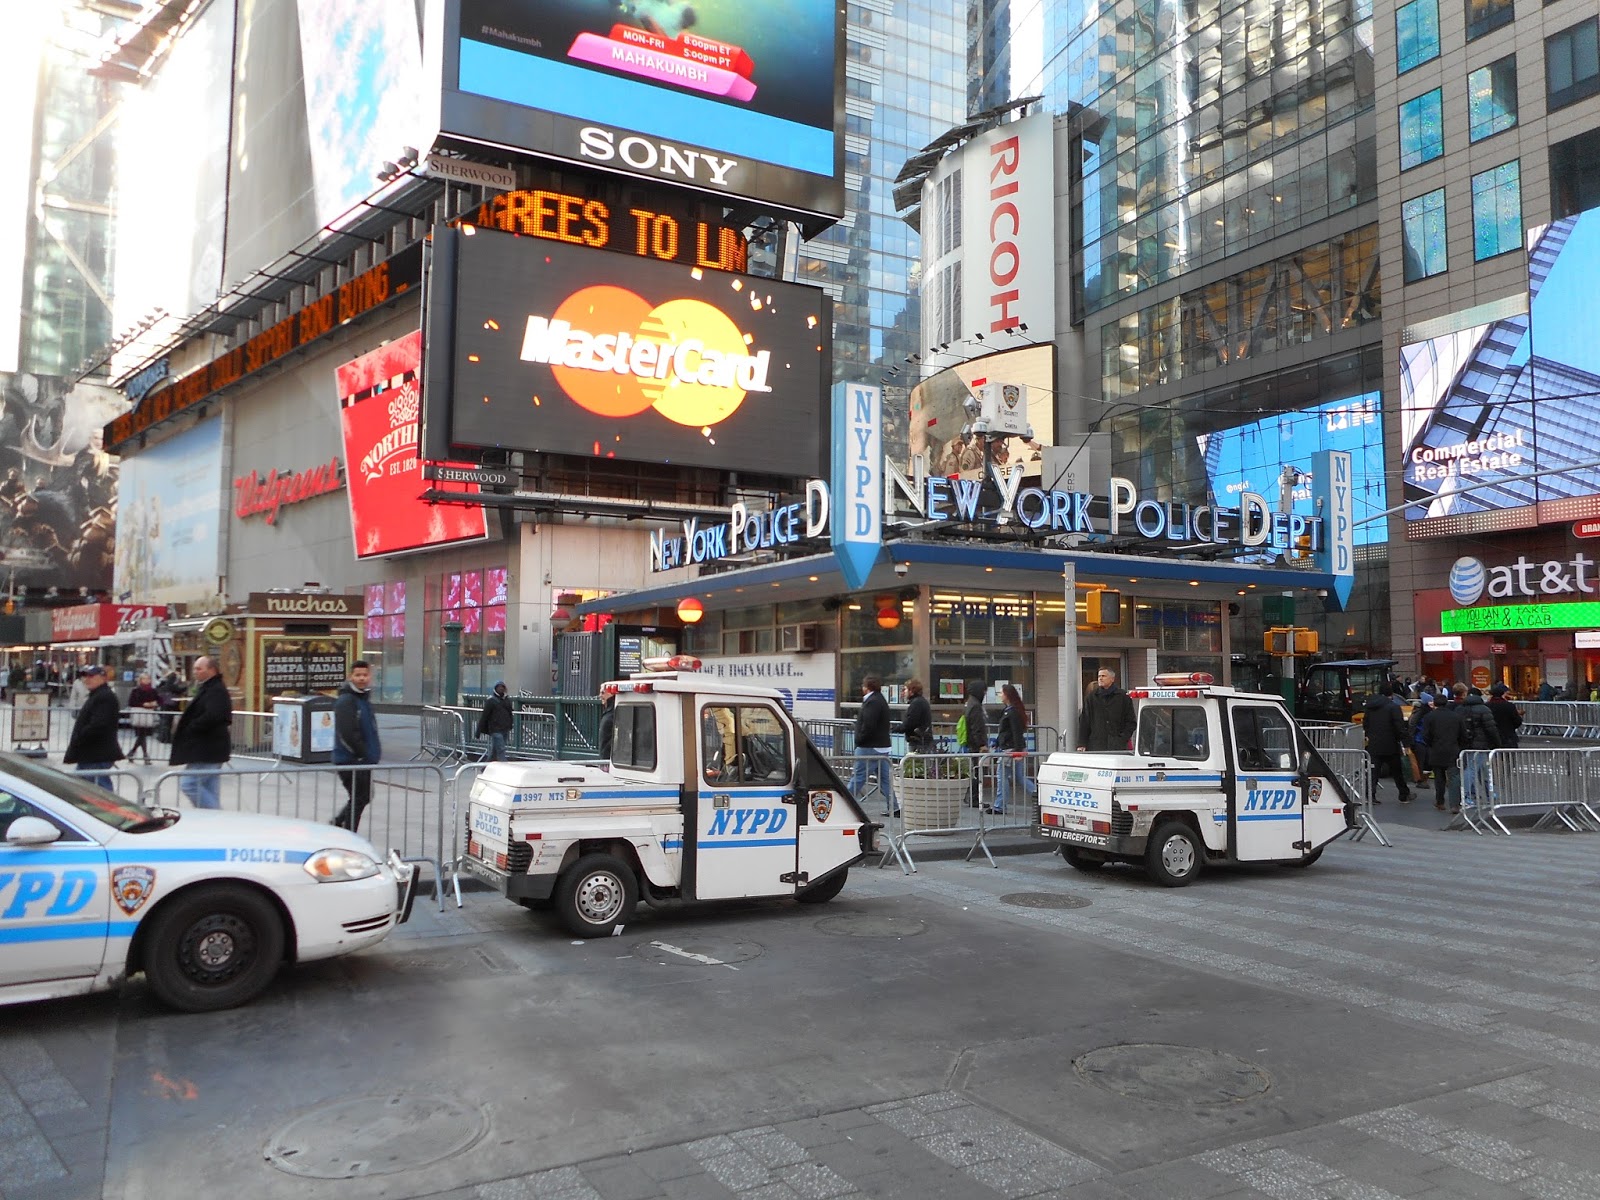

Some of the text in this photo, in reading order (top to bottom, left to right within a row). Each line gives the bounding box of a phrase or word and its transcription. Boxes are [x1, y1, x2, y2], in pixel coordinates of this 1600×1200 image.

[481, 24, 542, 48] #Mahakumbh
[623, 30, 665, 49] MON-FRI
[683, 36, 731, 56] 8:00pm ET
[612, 47, 708, 82] MAHAKUMBH
[683, 48, 731, 68] 5:00pm PT
[580, 126, 737, 186] SONY
[430, 160, 513, 186] SHERWOOD
[630, 208, 678, 260] TO
[990, 136, 1019, 334] RICOH
[520, 314, 772, 393] MasterCard
[1412, 428, 1523, 464] Commercial
[390, 461, 401, 475] EST.
[854, 390, 872, 536] NYPD
[1413, 451, 1522, 482] Real Estate
[437, 467, 506, 484] SHERWOOD
[885, 455, 984, 522] NEW
[988, 463, 1095, 533] YORK
[1110, 477, 1230, 543] POLICE
[1242, 491, 1322, 550] DEPT
[1335, 457, 1347, 570] NYPD
[650, 528, 681, 573] NEW
[683, 516, 727, 566] YORK
[732, 502, 799, 554] POLICE
[1487, 552, 1594, 598] at&t
[267, 595, 348, 612] nuchas
[1483, 608, 1499, 619] CAN
[1501, 607, 1512, 627] &
[1516, 615, 1552, 626] A CAB
[729, 663, 754, 677] TIMES
[522, 704, 544, 716] Subway
[523, 792, 564, 802] 3997 MTS
[1050, 796, 1098, 809] POLICE
[1055, 789, 1092, 800] NYPD
[1244, 789, 1297, 811] NYPD
[478, 810, 499, 825] NYPD
[707, 808, 787, 836] NYPD
[475, 820, 502, 837] POLICE
[1051, 829, 1098, 844] INTERCEPTOR
[229, 848, 283, 863] POLICE
